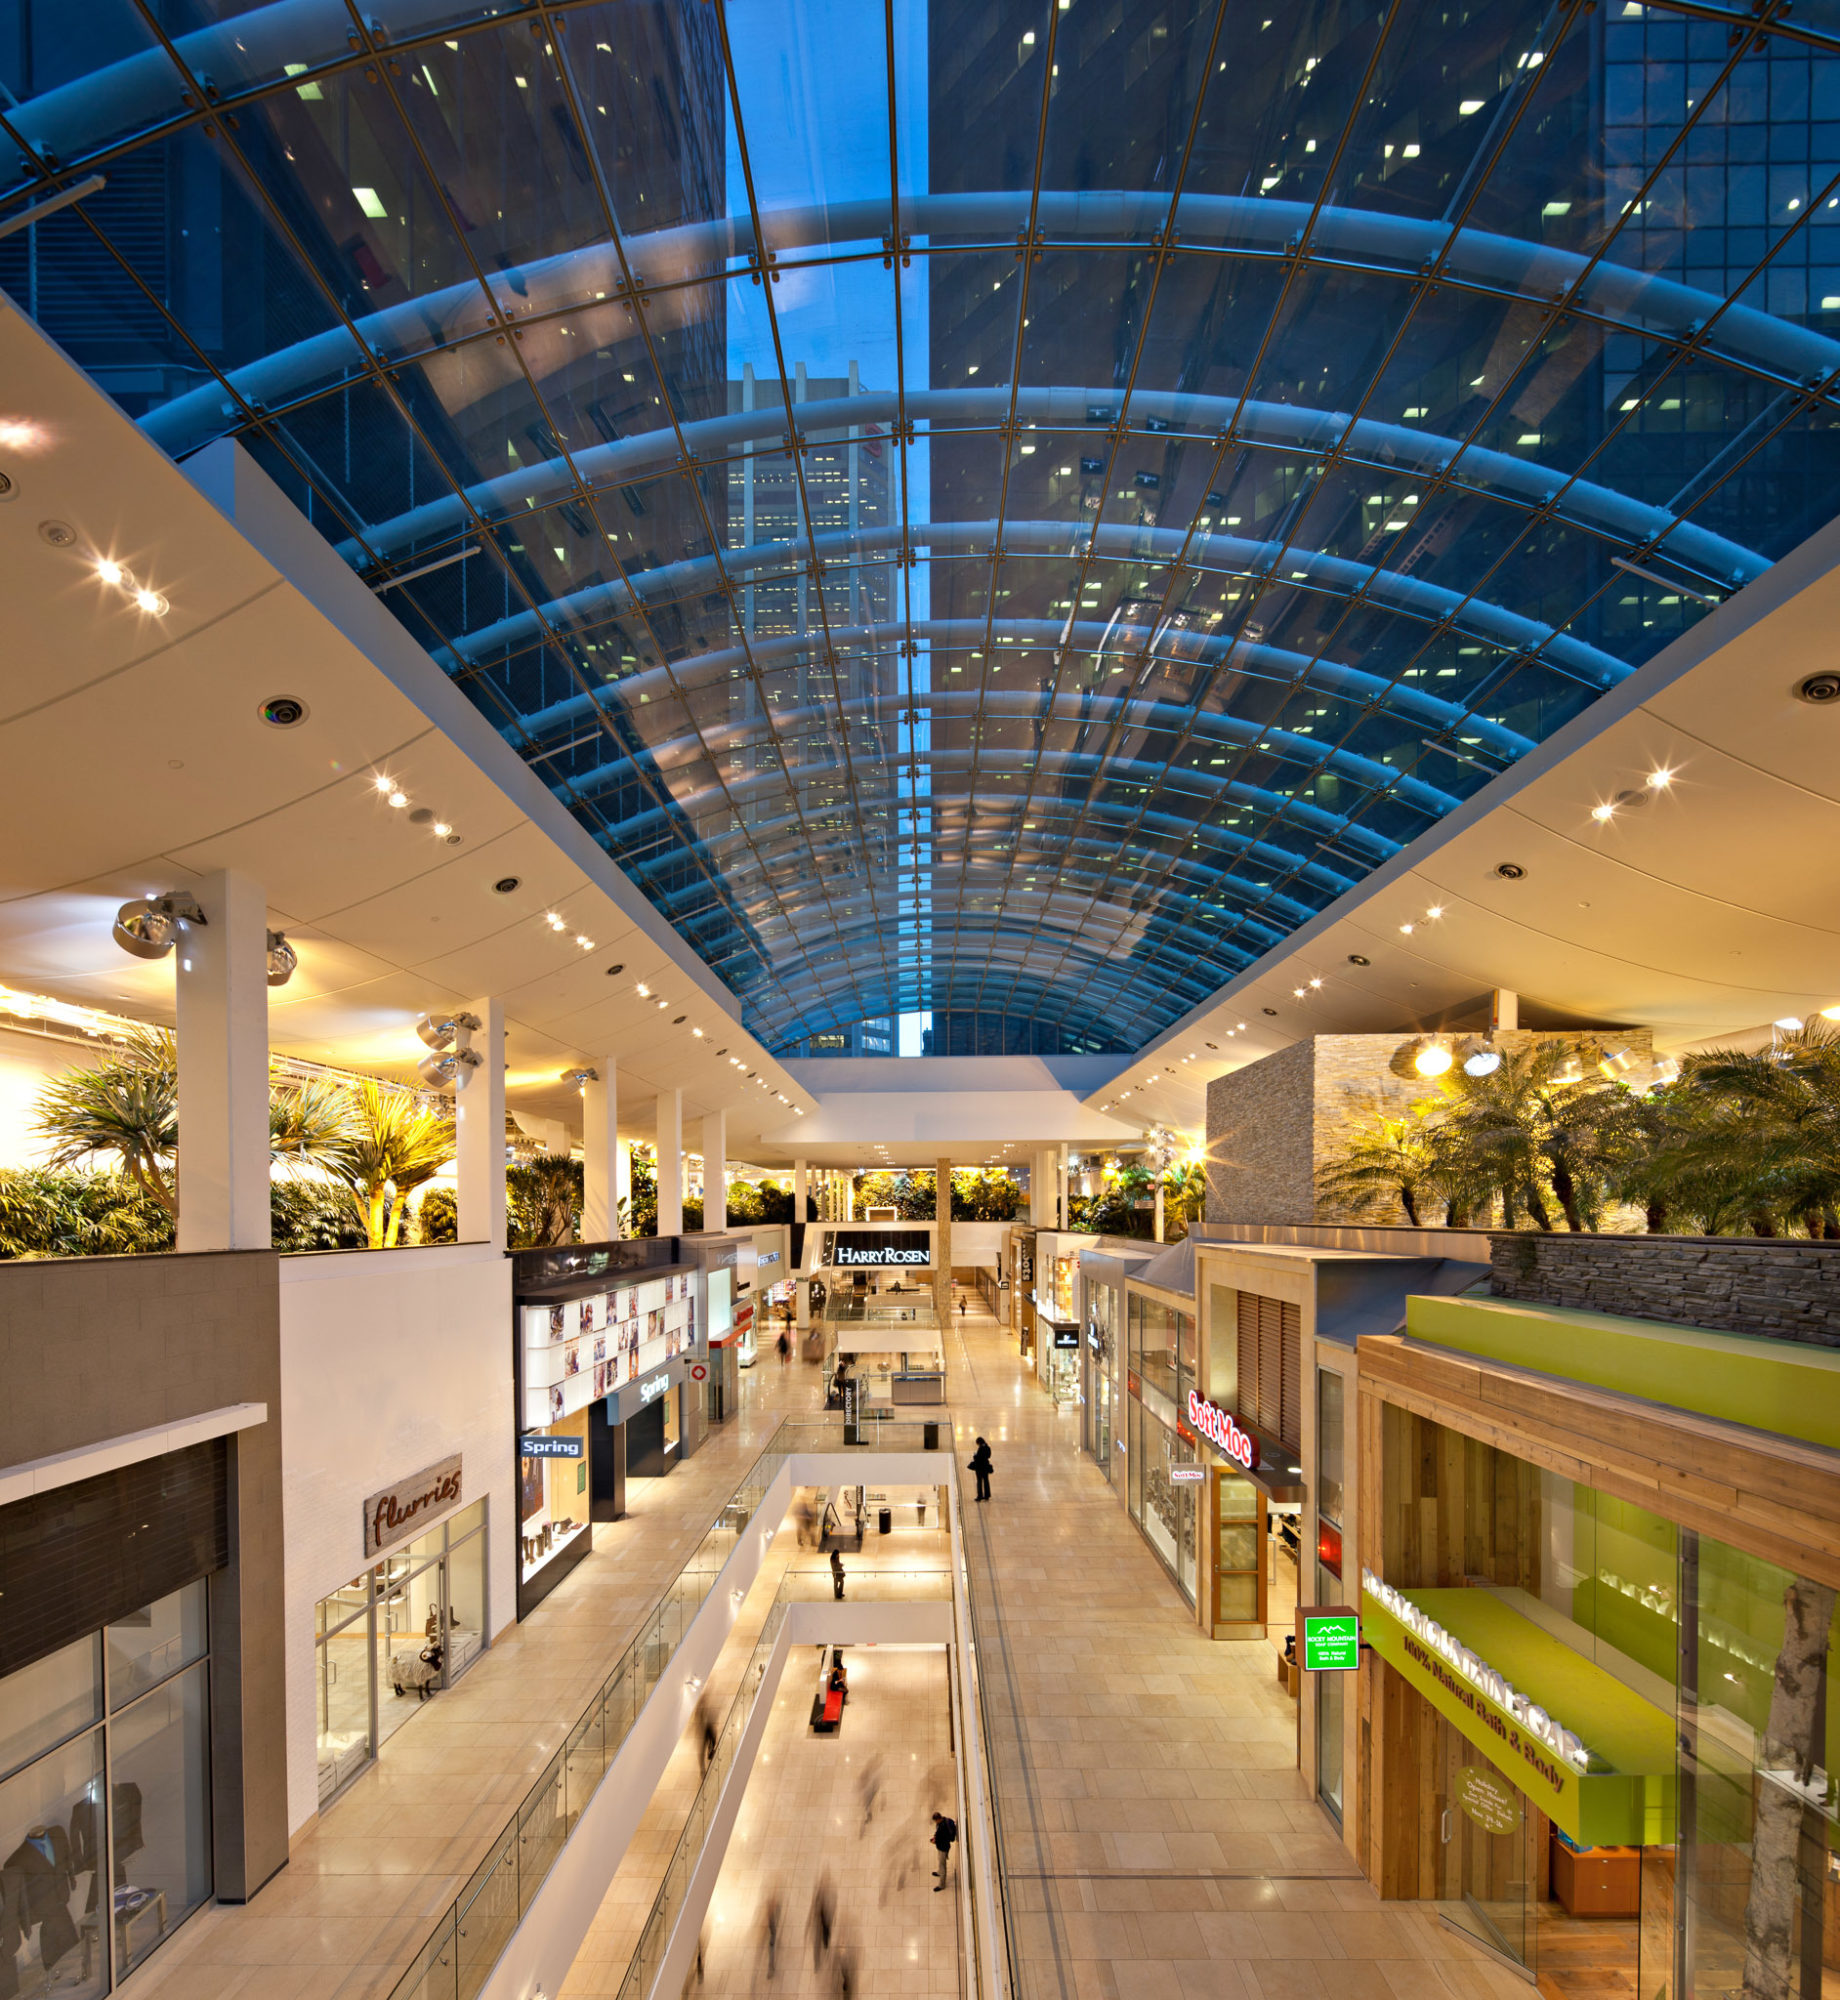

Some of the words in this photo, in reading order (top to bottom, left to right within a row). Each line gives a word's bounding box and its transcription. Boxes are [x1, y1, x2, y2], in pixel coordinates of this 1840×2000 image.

[837, 1247, 885, 1263] HARRY
[884, 1247, 931, 1263] ROSEN
[640, 1373, 669, 1403] Spring
[523, 1440, 579, 1455] Spring
[373, 1470, 461, 1547] flurries
[1403, 1635, 1431, 1672] 100%
[1432, 1660, 1474, 1711] Natural
[1475, 1697, 1507, 1741] Bath
[1508, 1729, 1521, 1754] &
[1523, 1741, 1564, 1794] Body
